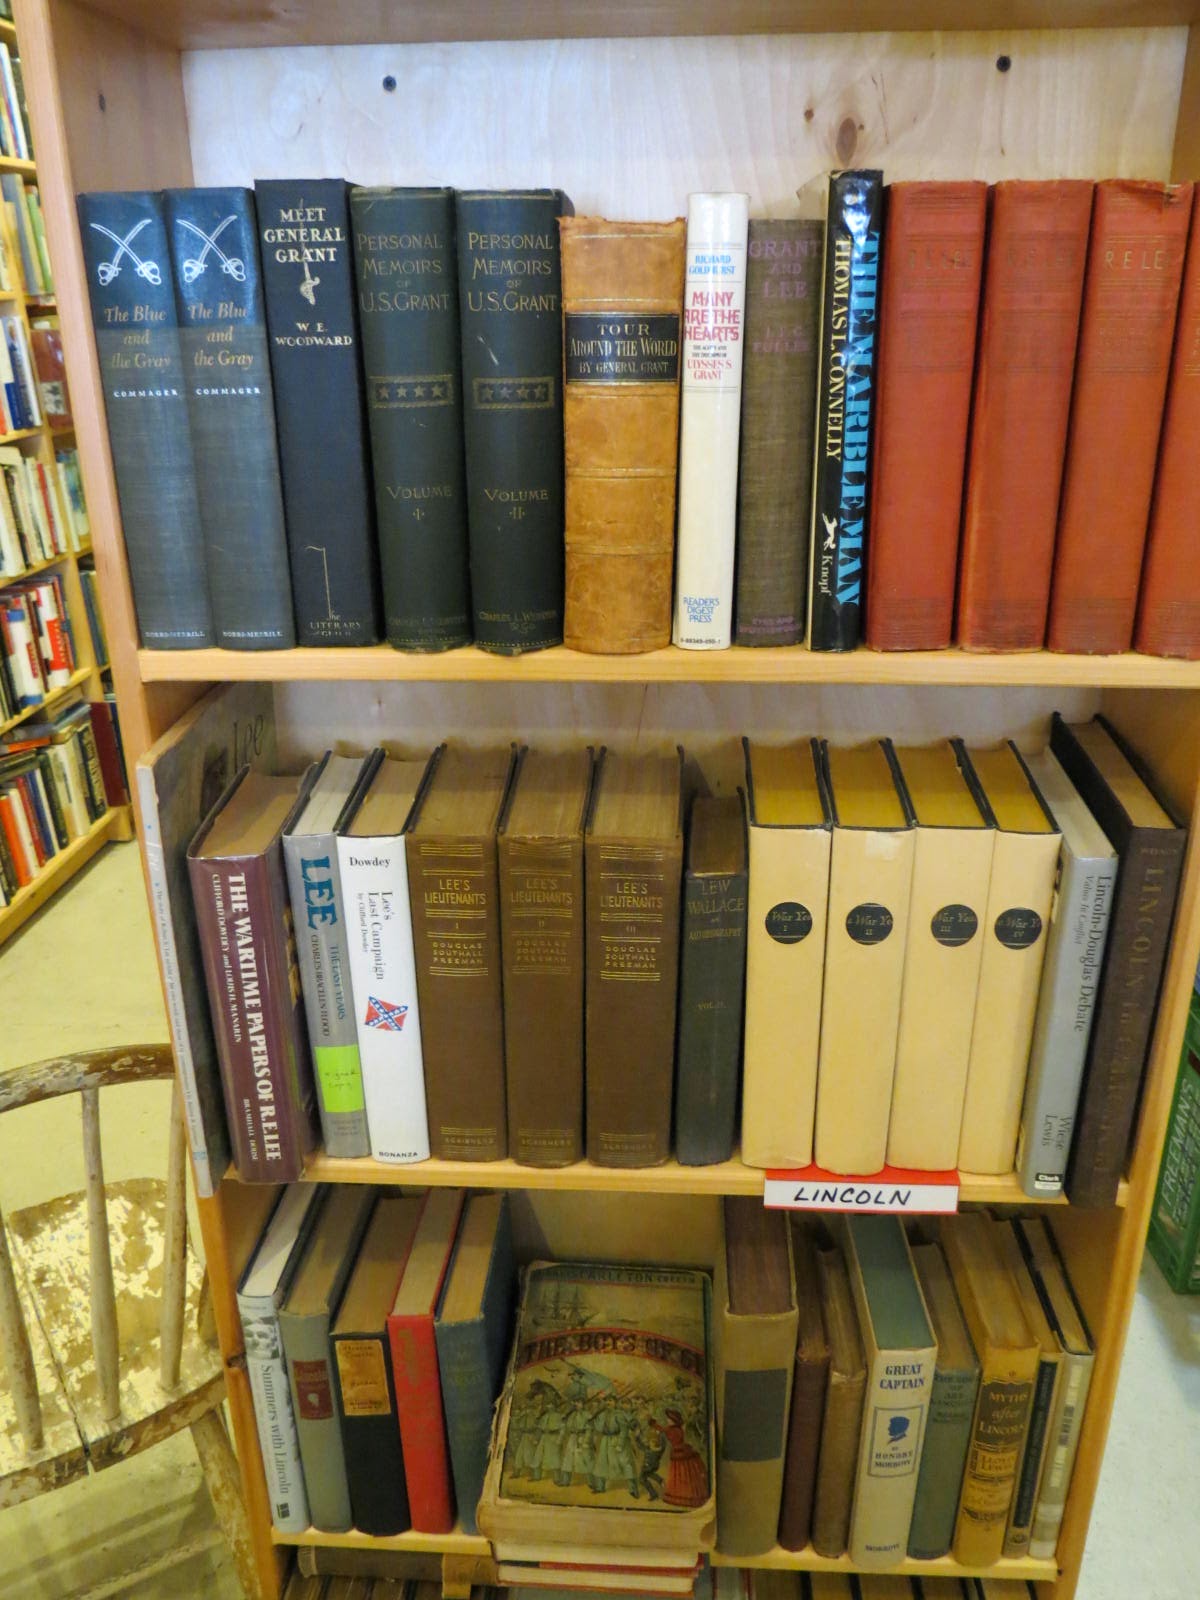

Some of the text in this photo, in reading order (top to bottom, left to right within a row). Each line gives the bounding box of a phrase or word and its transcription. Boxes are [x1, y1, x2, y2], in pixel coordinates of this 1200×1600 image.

[280, 208, 326, 222] MEET
[264, 228, 345, 243] GENERAL
[357, 232, 443, 250] PERSONAL
[468, 232, 553, 250] PERSONAL
[275, 248, 337, 263] GRANT
[749, 240, 820, 258] GRANT
[363, 259, 442, 279] MEMOIRS
[472, 259, 552, 280] MEMOIRS
[831, 237, 851, 330] THOMAS
[692, 291, 735, 307] MANY
[104, 306, 166, 322] The Blue
[187, 302, 250, 320] The Blue
[685, 309, 741, 324] ARE THE
[123, 330, 150, 345] and
[206, 327, 233, 342] and
[596, 323, 650, 336] TOUR
[684, 326, 739, 342] HEARTS
[275, 335, 352, 347] WOODWARD
[111, 352, 171, 372] the Gray
[194, 350, 254, 370] the Gray
[579, 361, 669, 374] BY GENERAL GRANT
[693, 370, 722, 380] GRANT
[113, 389, 178, 398] COMMAGER
[196, 387, 261, 396] COMMAGER
[826, 351, 847, 462] CONNELLY
[836, 231, 880, 605] THE MARBLE MAN
[386, 486, 452, 499] VOLUME
[484, 488, 549, 501] VOLUME
[817, 555, 833, 596] Knopf
[687, 606, 714, 614] DIGEST
[689, 614, 712, 623] PRESS
[349, 856, 391, 868] Dowdey
[439, 878, 471, 890] LEE'S
[616, 882, 648, 894] LEE'S
[701, 879, 731, 895] LEW
[228, 872, 249, 913] THE
[301, 855, 338, 931] LEE
[425, 893, 487, 905] LIEUTENANTS
[381, 892, 393, 921] Lee's
[600, 896, 663, 909] LIEUTENANTS
[688, 898, 744, 914] WALLACE
[772, 911, 793, 922] War
[856, 914, 876, 926] War
[368, 892, 387, 980] Last Campaign
[1125, 868, 1165, 988] LINCOLN
[1074, 876, 1112, 1032] Lincoln-Douglas Debate
[234, 916, 262, 1009] WARTIME
[246, 1012, 271, 1078] PAPERS
[256, 1079, 274, 1101] OF
[1042, 1114, 1058, 1147] Lewis
[1056, 1116, 1073, 1150] Wiese
[1161, 1077, 1195, 1206] FREEMAN'S
[794, 1187, 911, 1206] LINCOLN
[578, 1331, 636, 1352] BOYS
[885, 1363, 923, 1376] GREAT
[880, 1378, 925, 1390] CAPTAIN
[261, 1364, 290, 1494] Summers with Lincoln
[979, 1422, 1025, 1435] LINCOLN
